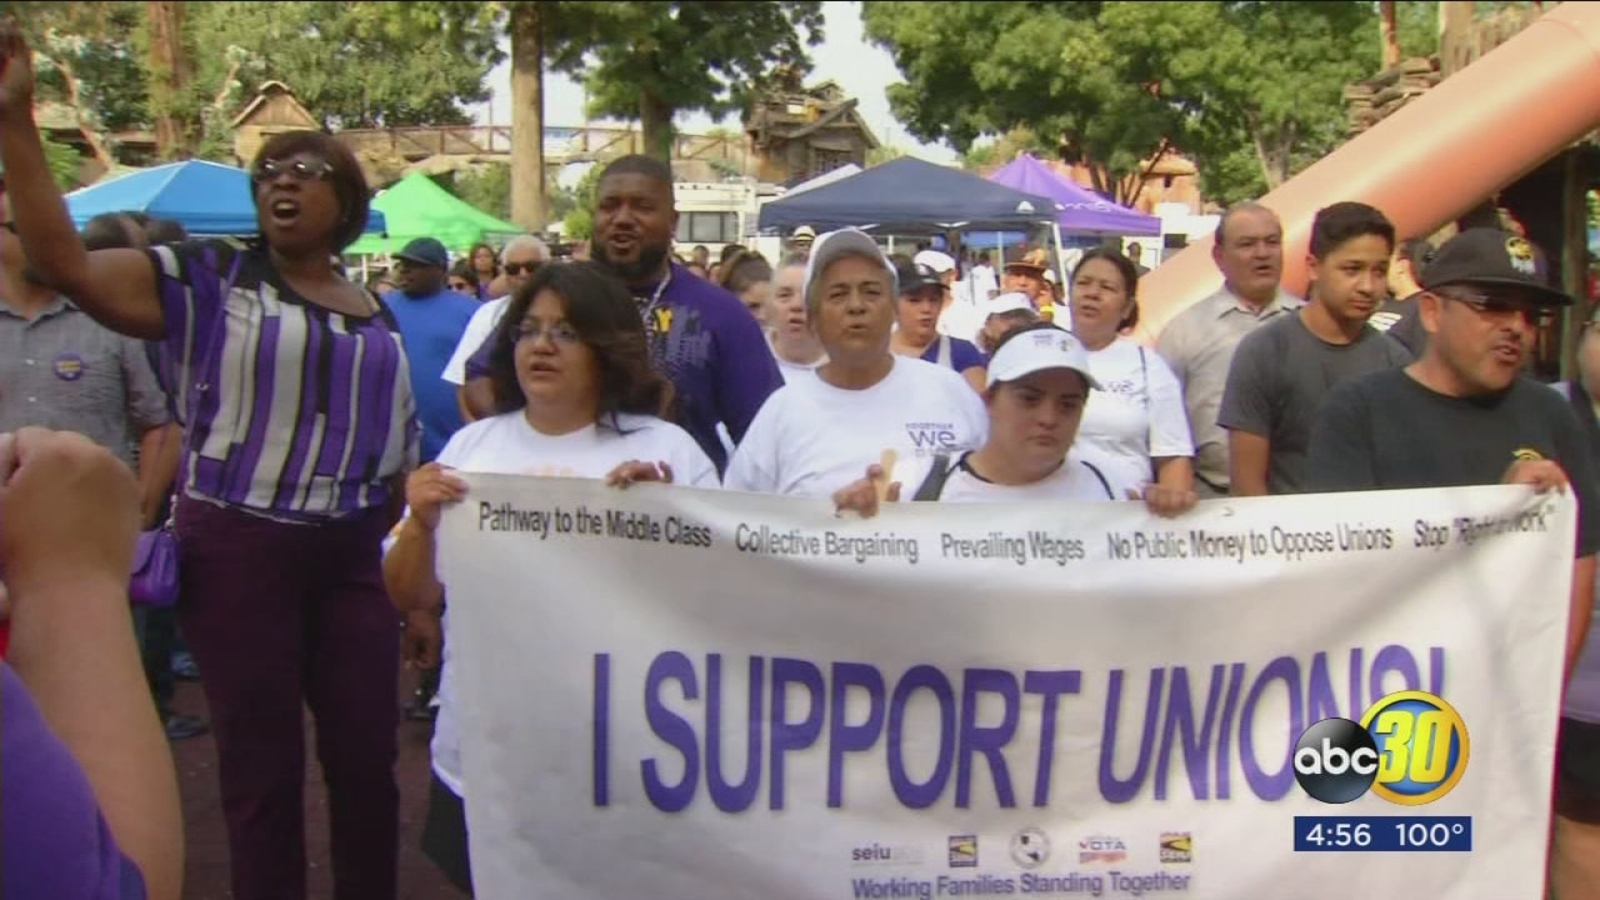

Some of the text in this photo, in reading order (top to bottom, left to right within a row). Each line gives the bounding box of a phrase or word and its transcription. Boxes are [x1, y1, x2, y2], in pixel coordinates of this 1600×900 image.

[479, 501, 711, 547] Pathway to the Middle Class
[1414, 519, 1449, 550] Stop
[735, 523, 918, 564] Collective Bargaining
[942, 531, 1085, 566] Prevailing Wages
[1107, 523, 1393, 563] No Public Money to Oppose Unions
[594, 653, 610, 806] I
[640, 650, 1082, 814] SUPPORT
[852, 842, 891, 860] seiu
[852, 871, 1191, 900] Working Families Standing Together
